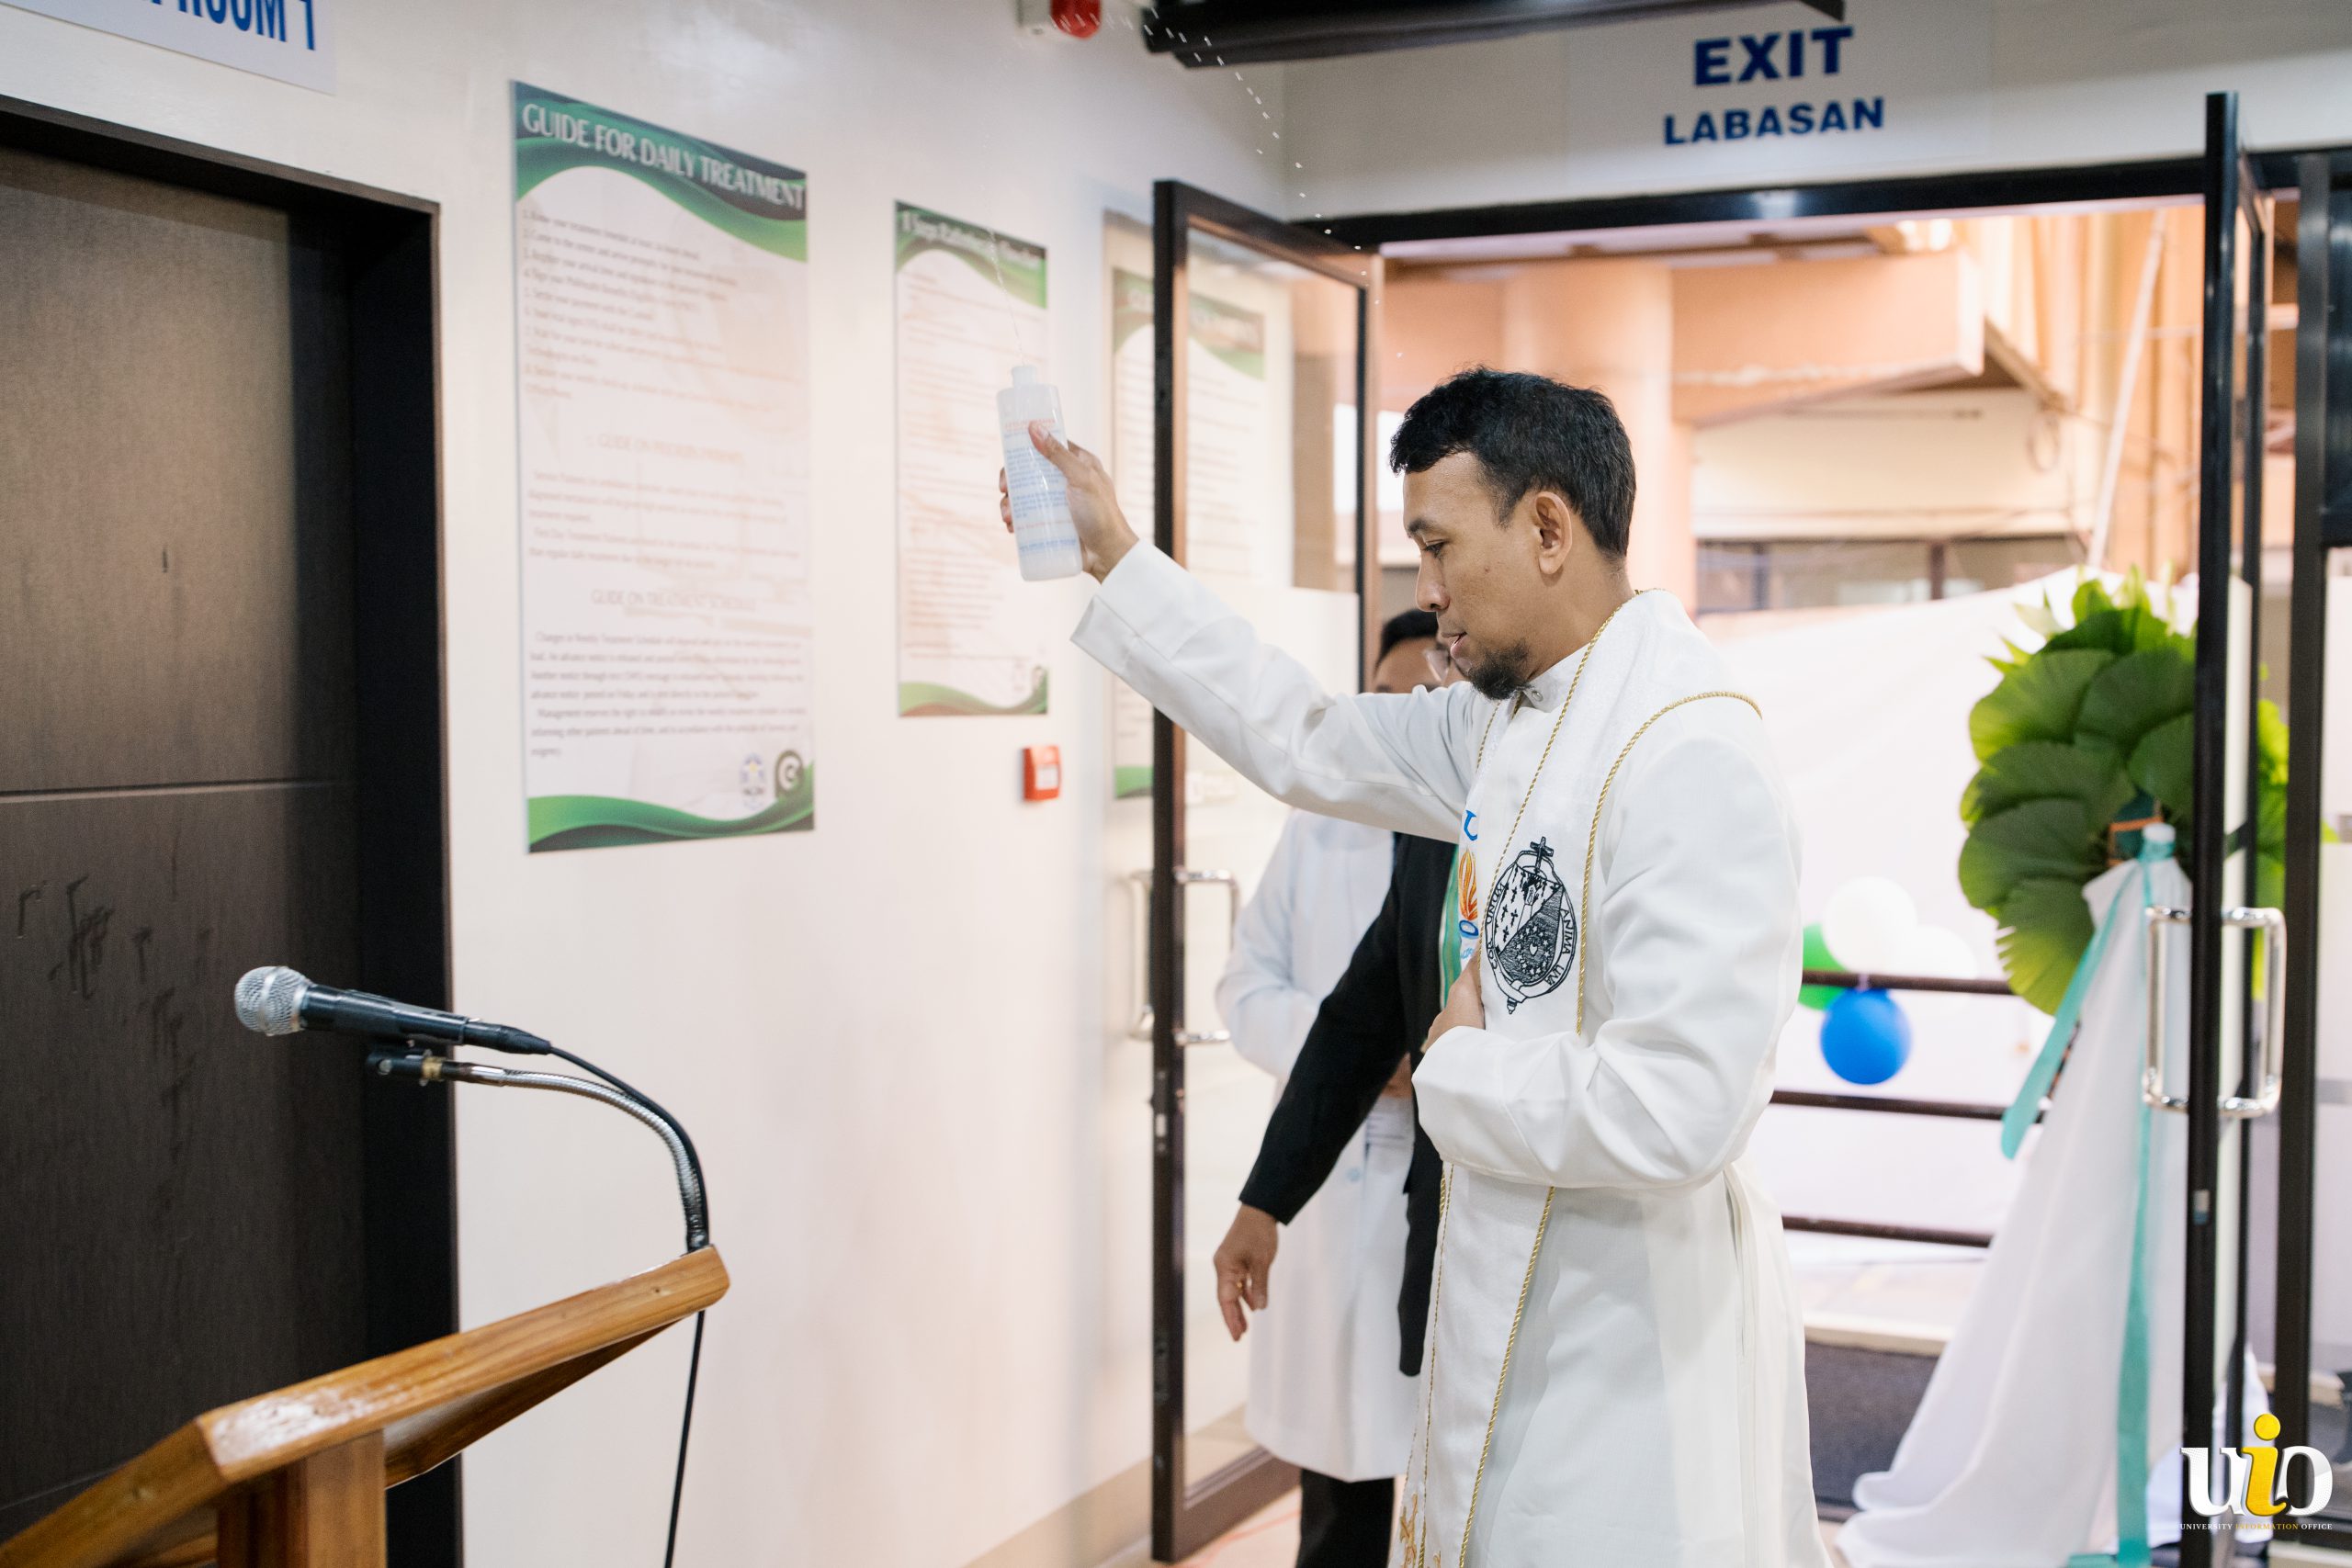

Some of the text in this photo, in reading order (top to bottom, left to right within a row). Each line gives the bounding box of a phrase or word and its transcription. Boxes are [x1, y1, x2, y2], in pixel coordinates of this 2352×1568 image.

[178, 0, 287, 42] OM
[1694, 26, 1853, 85] EXIT
[1664, 96, 1883, 145] LABASAN
[522, 103, 806, 210] GUIDE FOR DAILY TREATMENT
[1486, 882, 1507, 925] UNUM
[1545, 908, 1575, 987] ANIMA UNA
